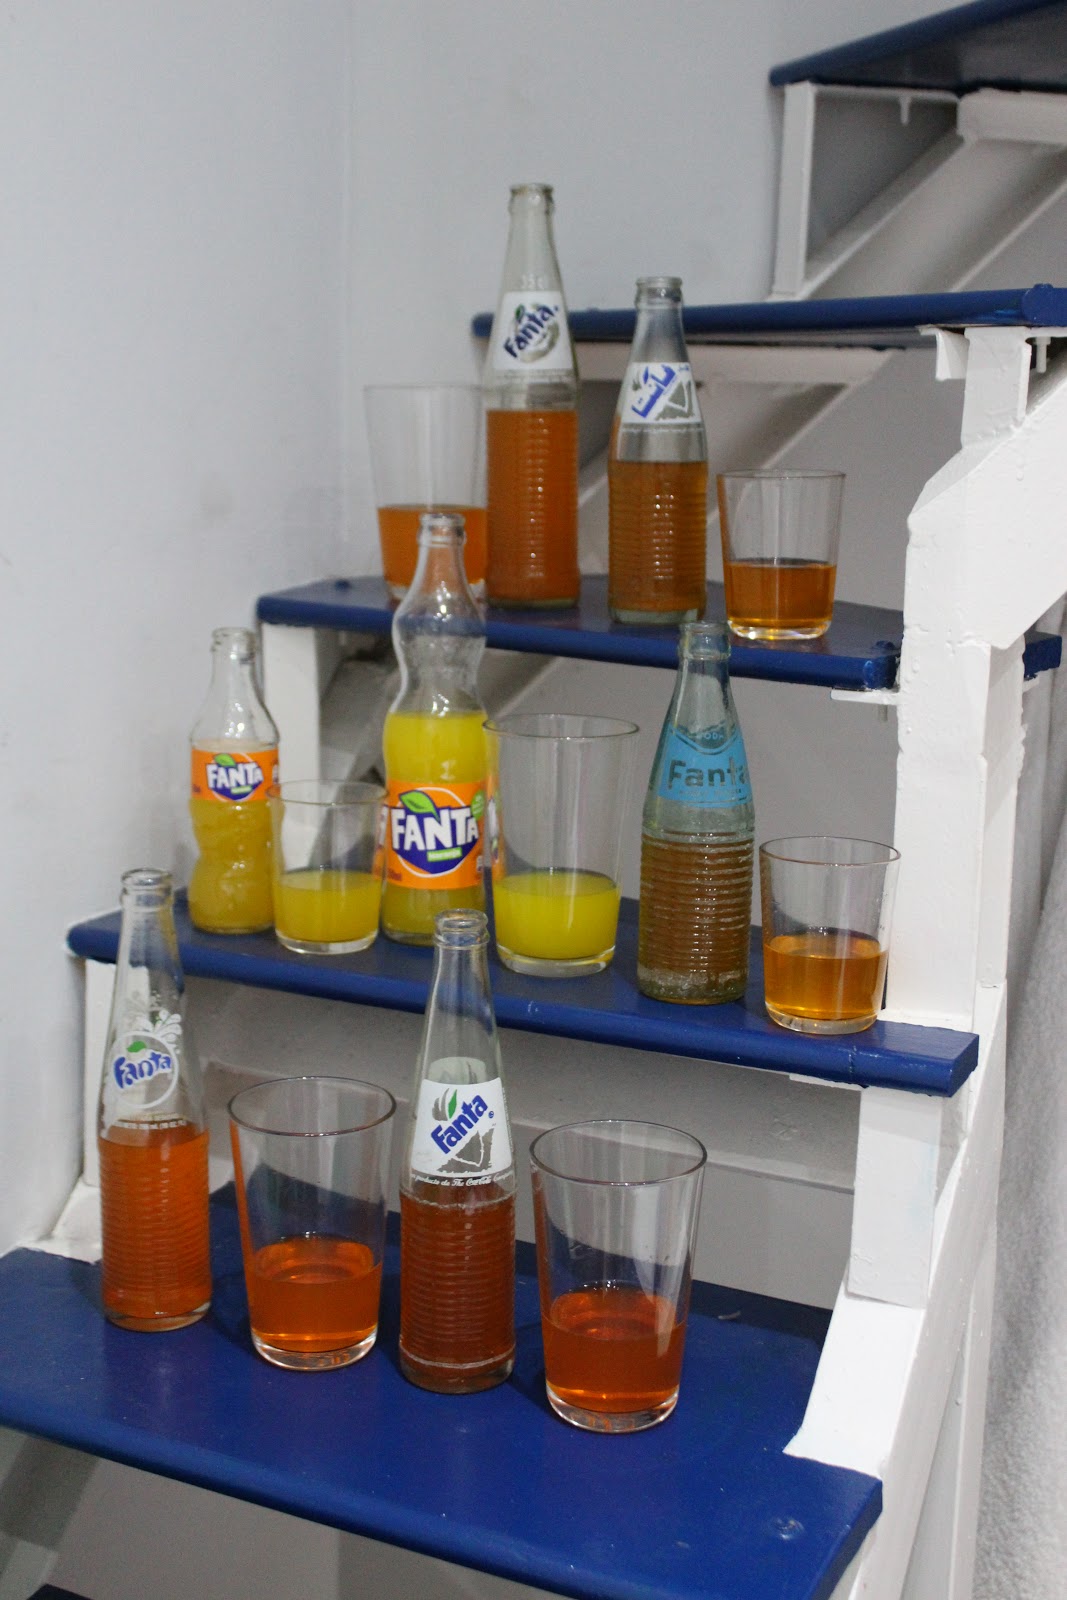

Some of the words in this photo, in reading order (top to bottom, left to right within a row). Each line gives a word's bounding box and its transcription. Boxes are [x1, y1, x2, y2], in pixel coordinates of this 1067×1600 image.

[503, 305, 555, 358] Fanta
[206, 761, 264, 789] FANTA
[391, 806, 479, 851] FANTA
[113, 1052, 172, 1089] Fanta
[430, 1095, 488, 1155] Fanta
